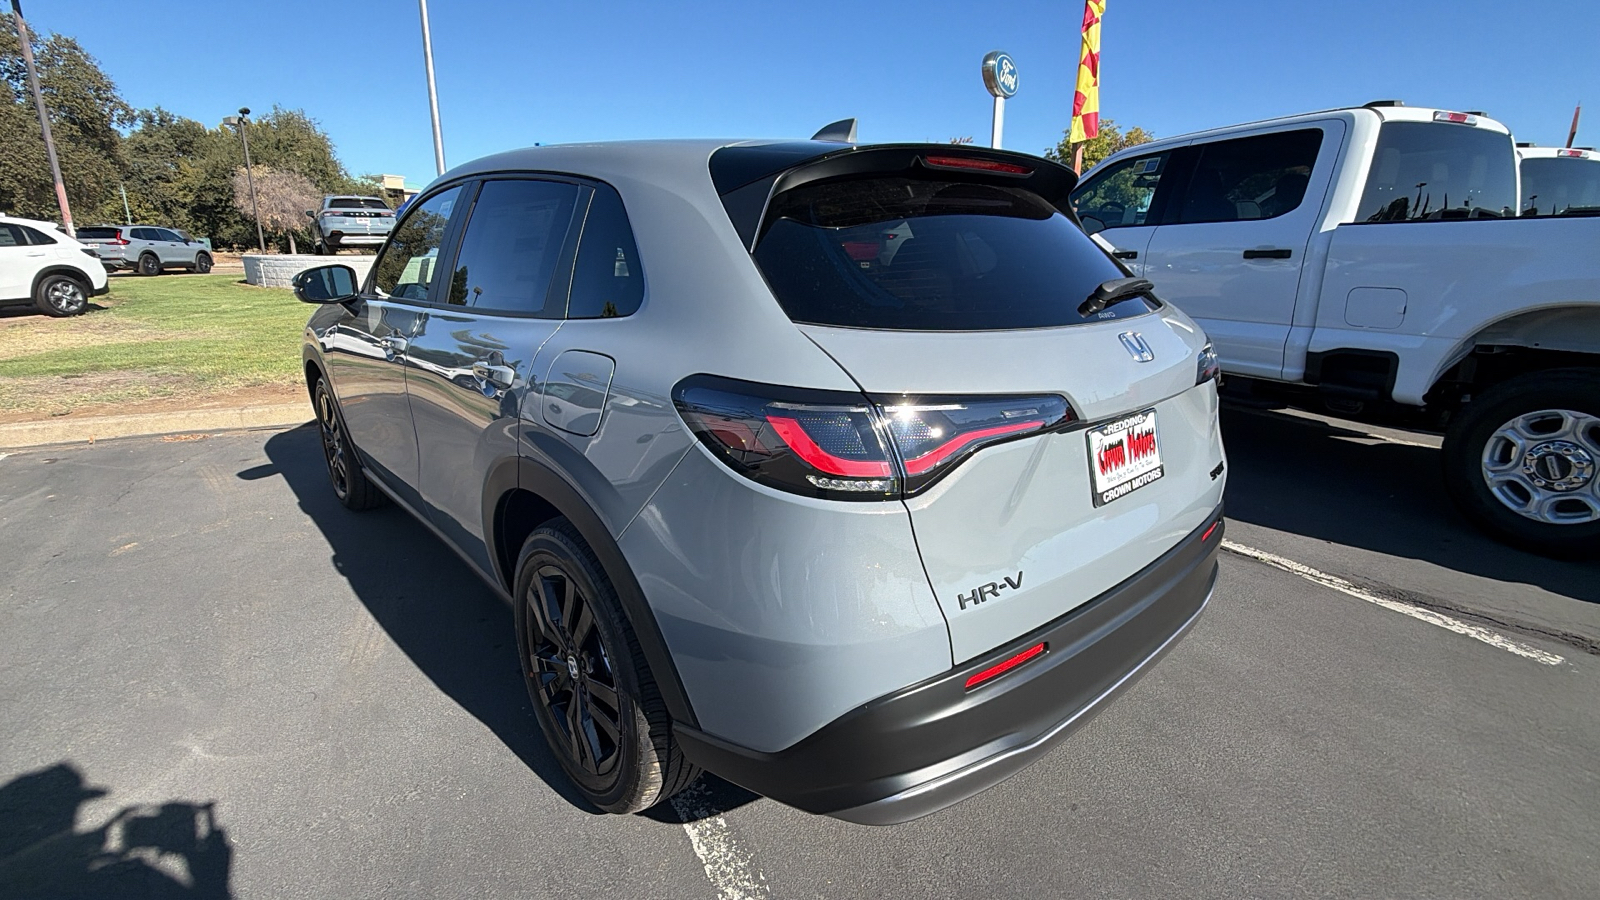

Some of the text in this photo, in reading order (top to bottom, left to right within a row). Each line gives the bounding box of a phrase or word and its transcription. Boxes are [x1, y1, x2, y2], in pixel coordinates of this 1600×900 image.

[1001, 59, 1017, 90] Ford
[1098, 311, 1116, 319] AWD
[1107, 414, 1143, 434] REDDING
[1127, 426, 1156, 464] Motors
[1102, 481, 1132, 503] CROWN
[1132, 468, 1162, 490] MOTORS
[957, 570, 1023, 610] HR-V
